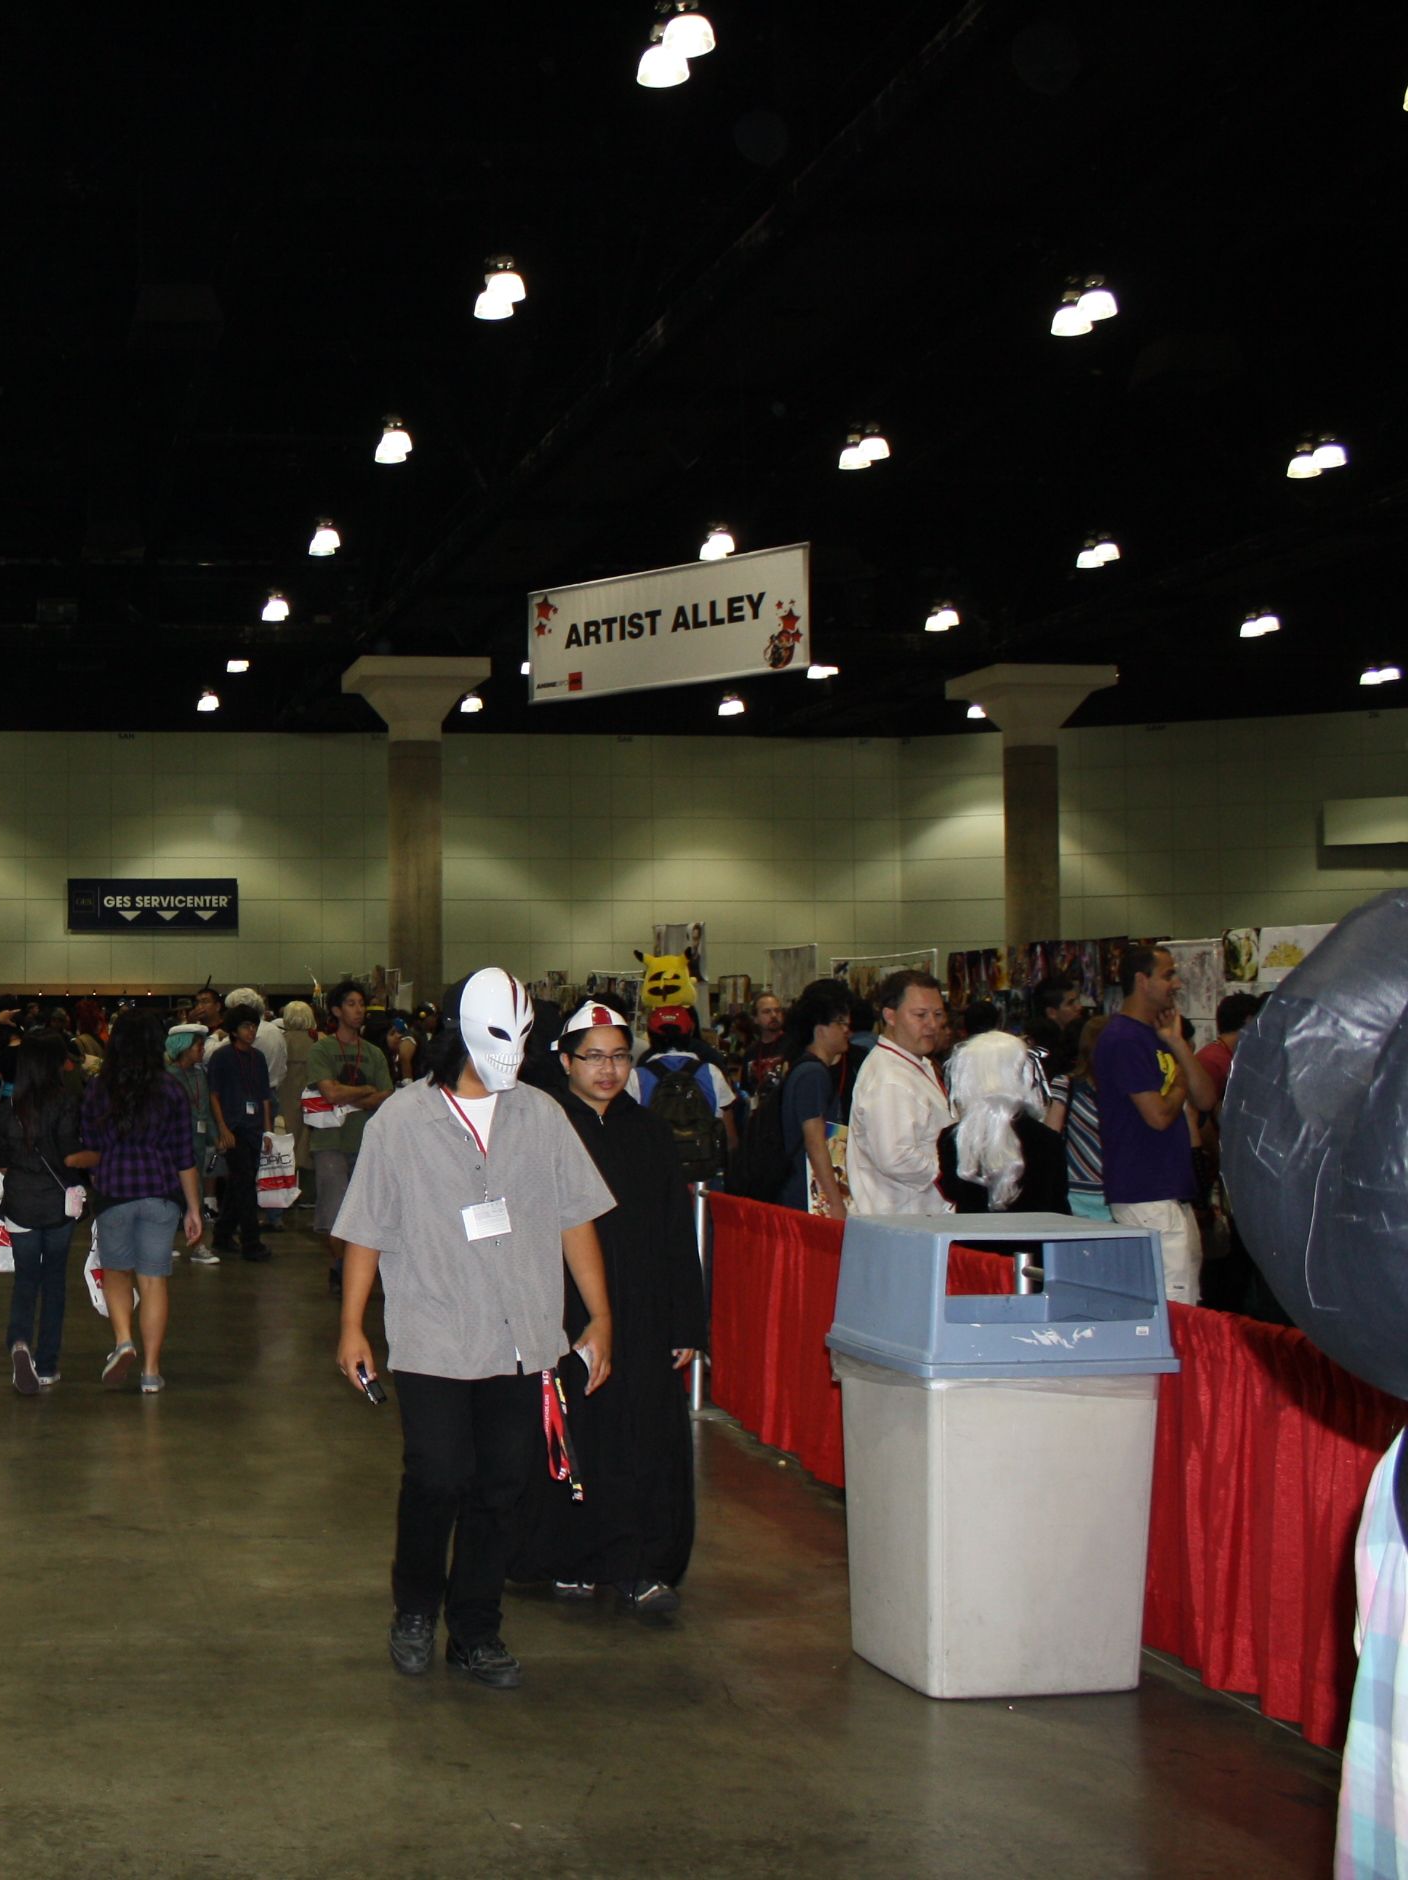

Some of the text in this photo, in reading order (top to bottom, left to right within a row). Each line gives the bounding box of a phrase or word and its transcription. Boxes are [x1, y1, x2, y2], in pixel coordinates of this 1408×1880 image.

[565, 591, 766, 649] ARTIST ALLEY
[103, 896, 131, 908] GES
